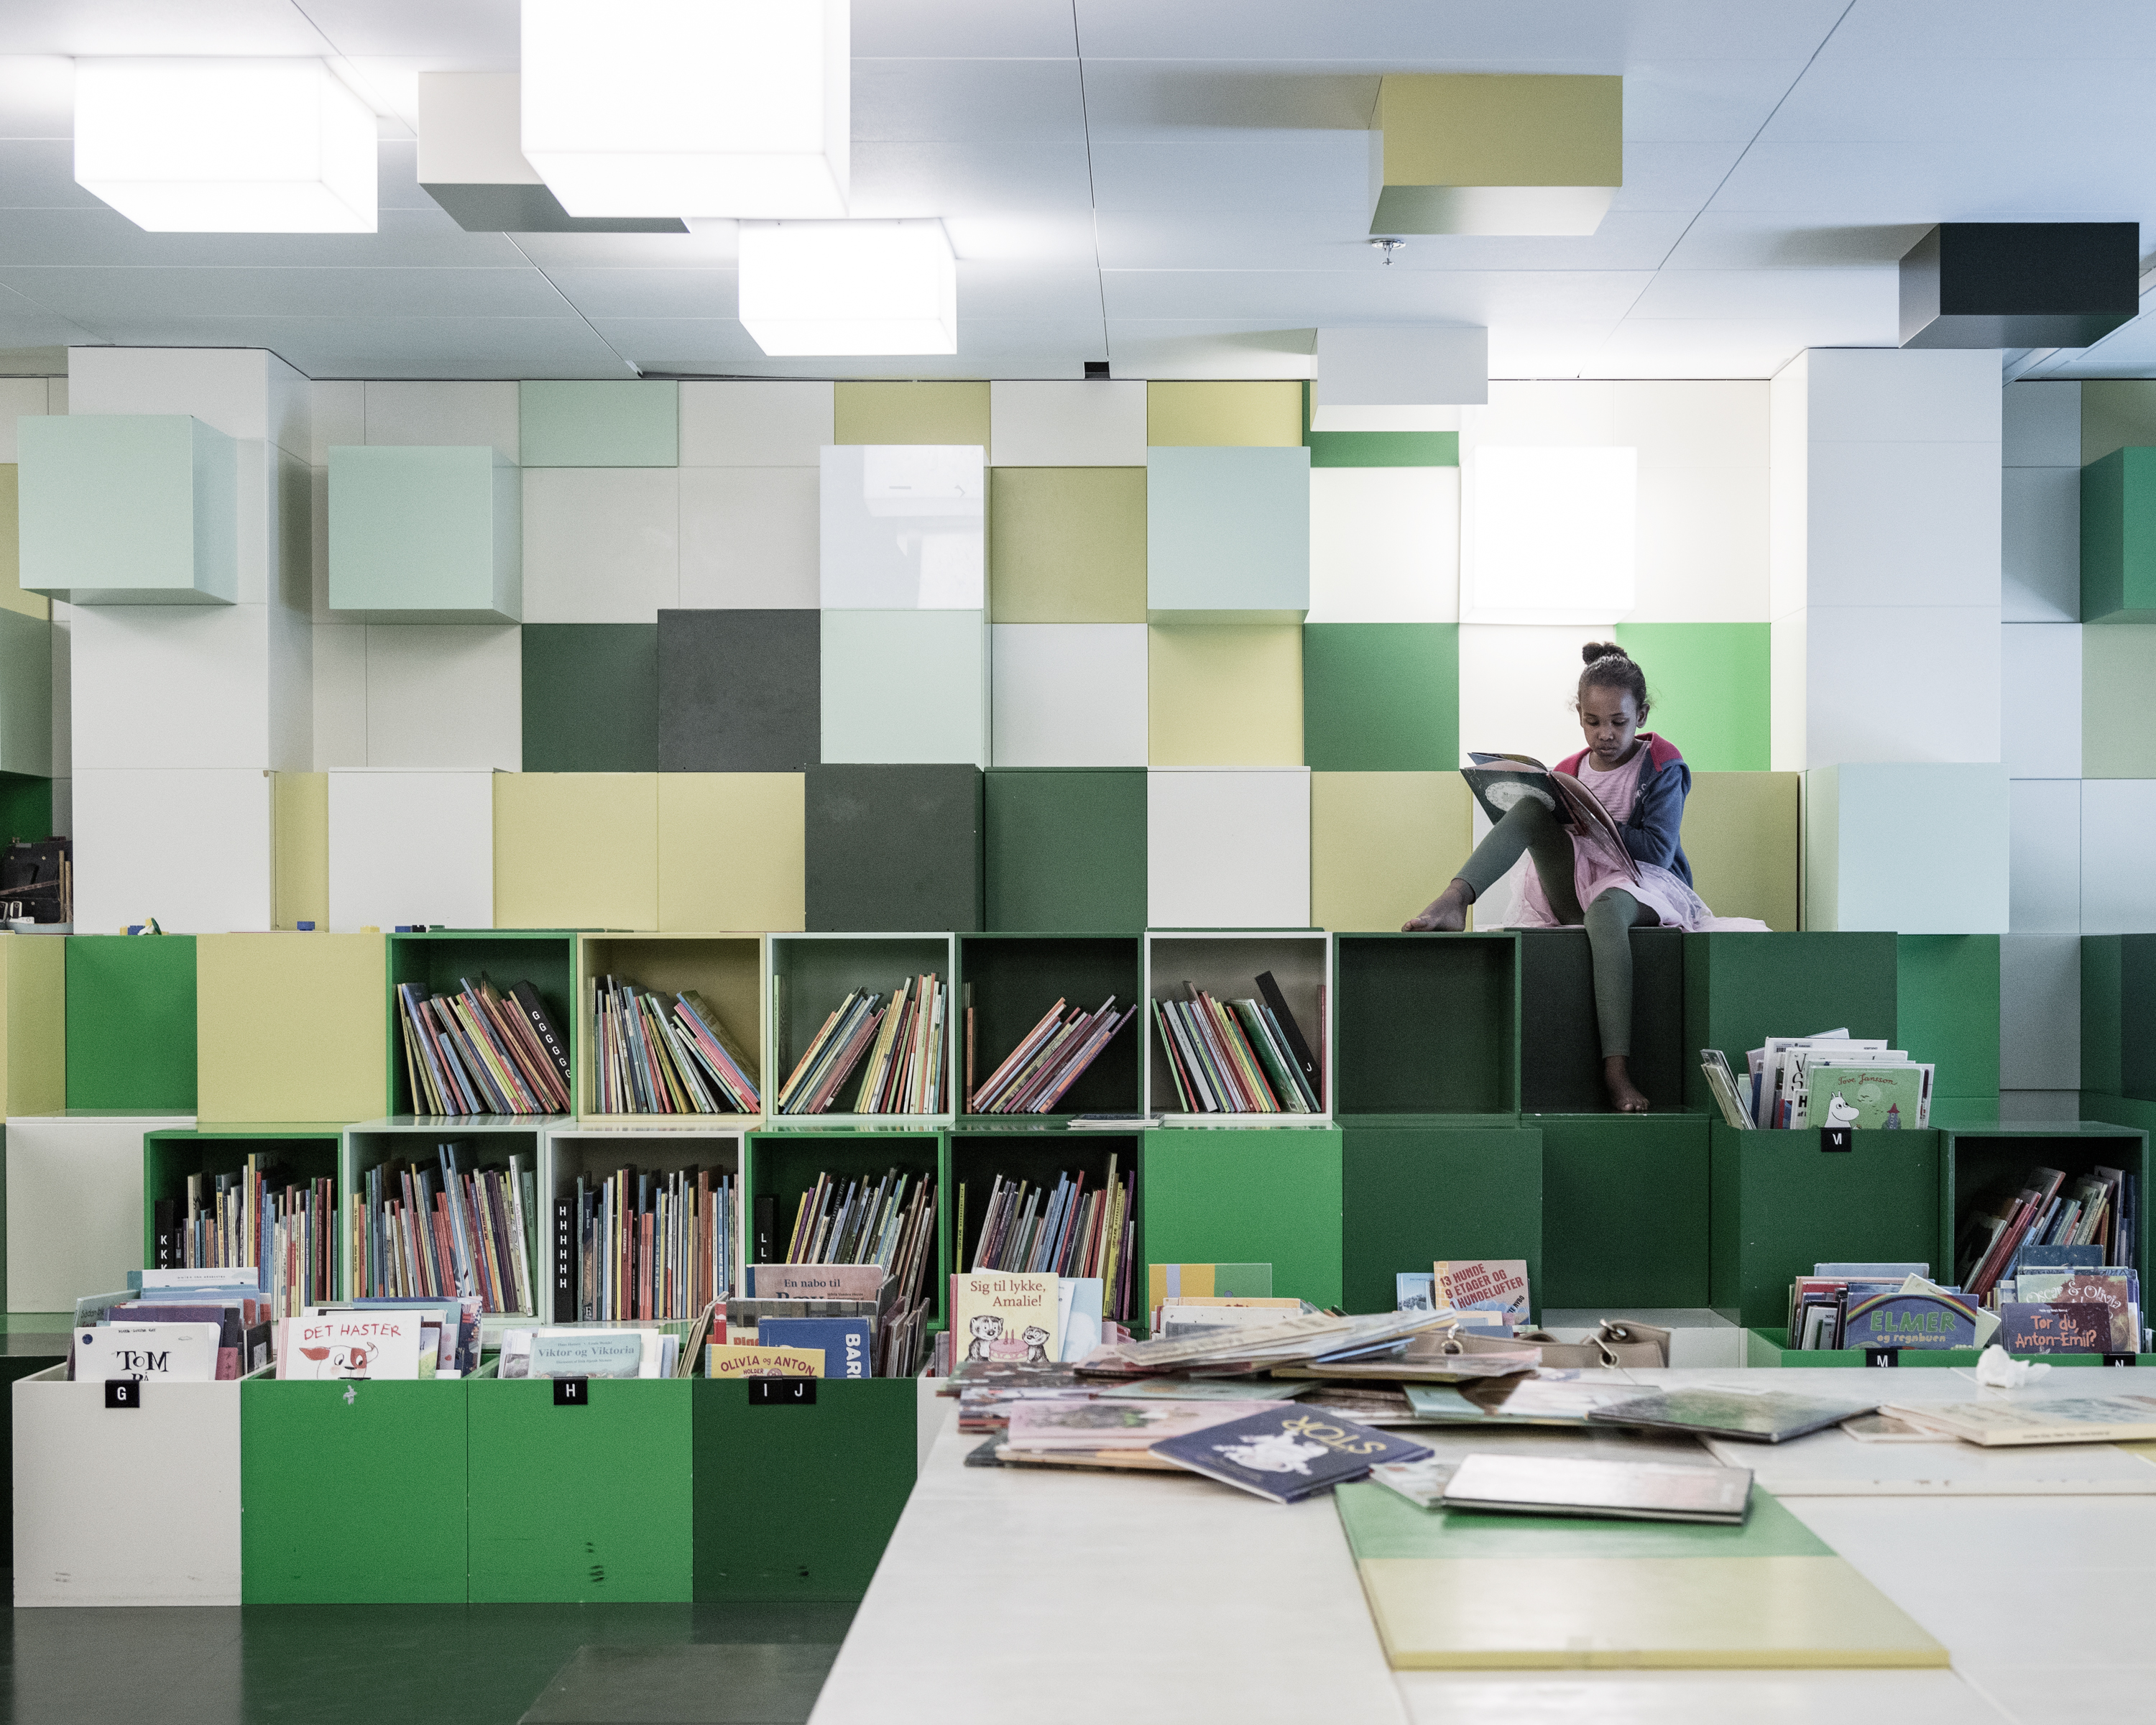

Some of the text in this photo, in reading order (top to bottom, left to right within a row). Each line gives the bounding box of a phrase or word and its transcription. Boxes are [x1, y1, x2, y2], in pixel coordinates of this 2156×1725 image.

[1307, 1062, 1312, 1072] J
[1838, 1073, 1897, 1085] Tove Jansson
[160, 1235, 167, 1245] K
[559, 1206, 567, 1288] H H H H H H
[761, 1233, 767, 1257] L L
[160, 1250, 167, 1259] K
[1439, 1263, 1486, 1287] 13 HUNDE
[784, 1279, 841, 1288] En nabo til
[970, 1279, 1046, 1295] Sig til lykke,
[1445, 1269, 1508, 1300] 9 ETAGER OG
[1450, 1276, 1524, 1309] 1 HUNDELUFTER
[2027, 1281, 2121, 1309] Oscar & Olivia
[992, 1296, 1041, 1307] Amalie!
[1870, 1310, 1956, 1333] ELMER
[2030, 1315, 2079, 1333] Tør du,
[304, 1323, 401, 1340] DET HASTER
[1877, 1333, 1946, 1343] og regnbuen
[2015, 1330, 2097, 1348] Anton-Emil?
[538, 1346, 635, 1358] Viktor og Viktoria
[845, 1333, 862, 1379] BAR
[720, 1356, 815, 1376] OLIVIA og ANTON
[1877, 1355, 1889, 1367] M
[117, 1386, 126, 1400] G
[566, 1384, 576, 1397] H
[764, 1383, 768, 1397] I
[794, 1383, 803, 1397] J
